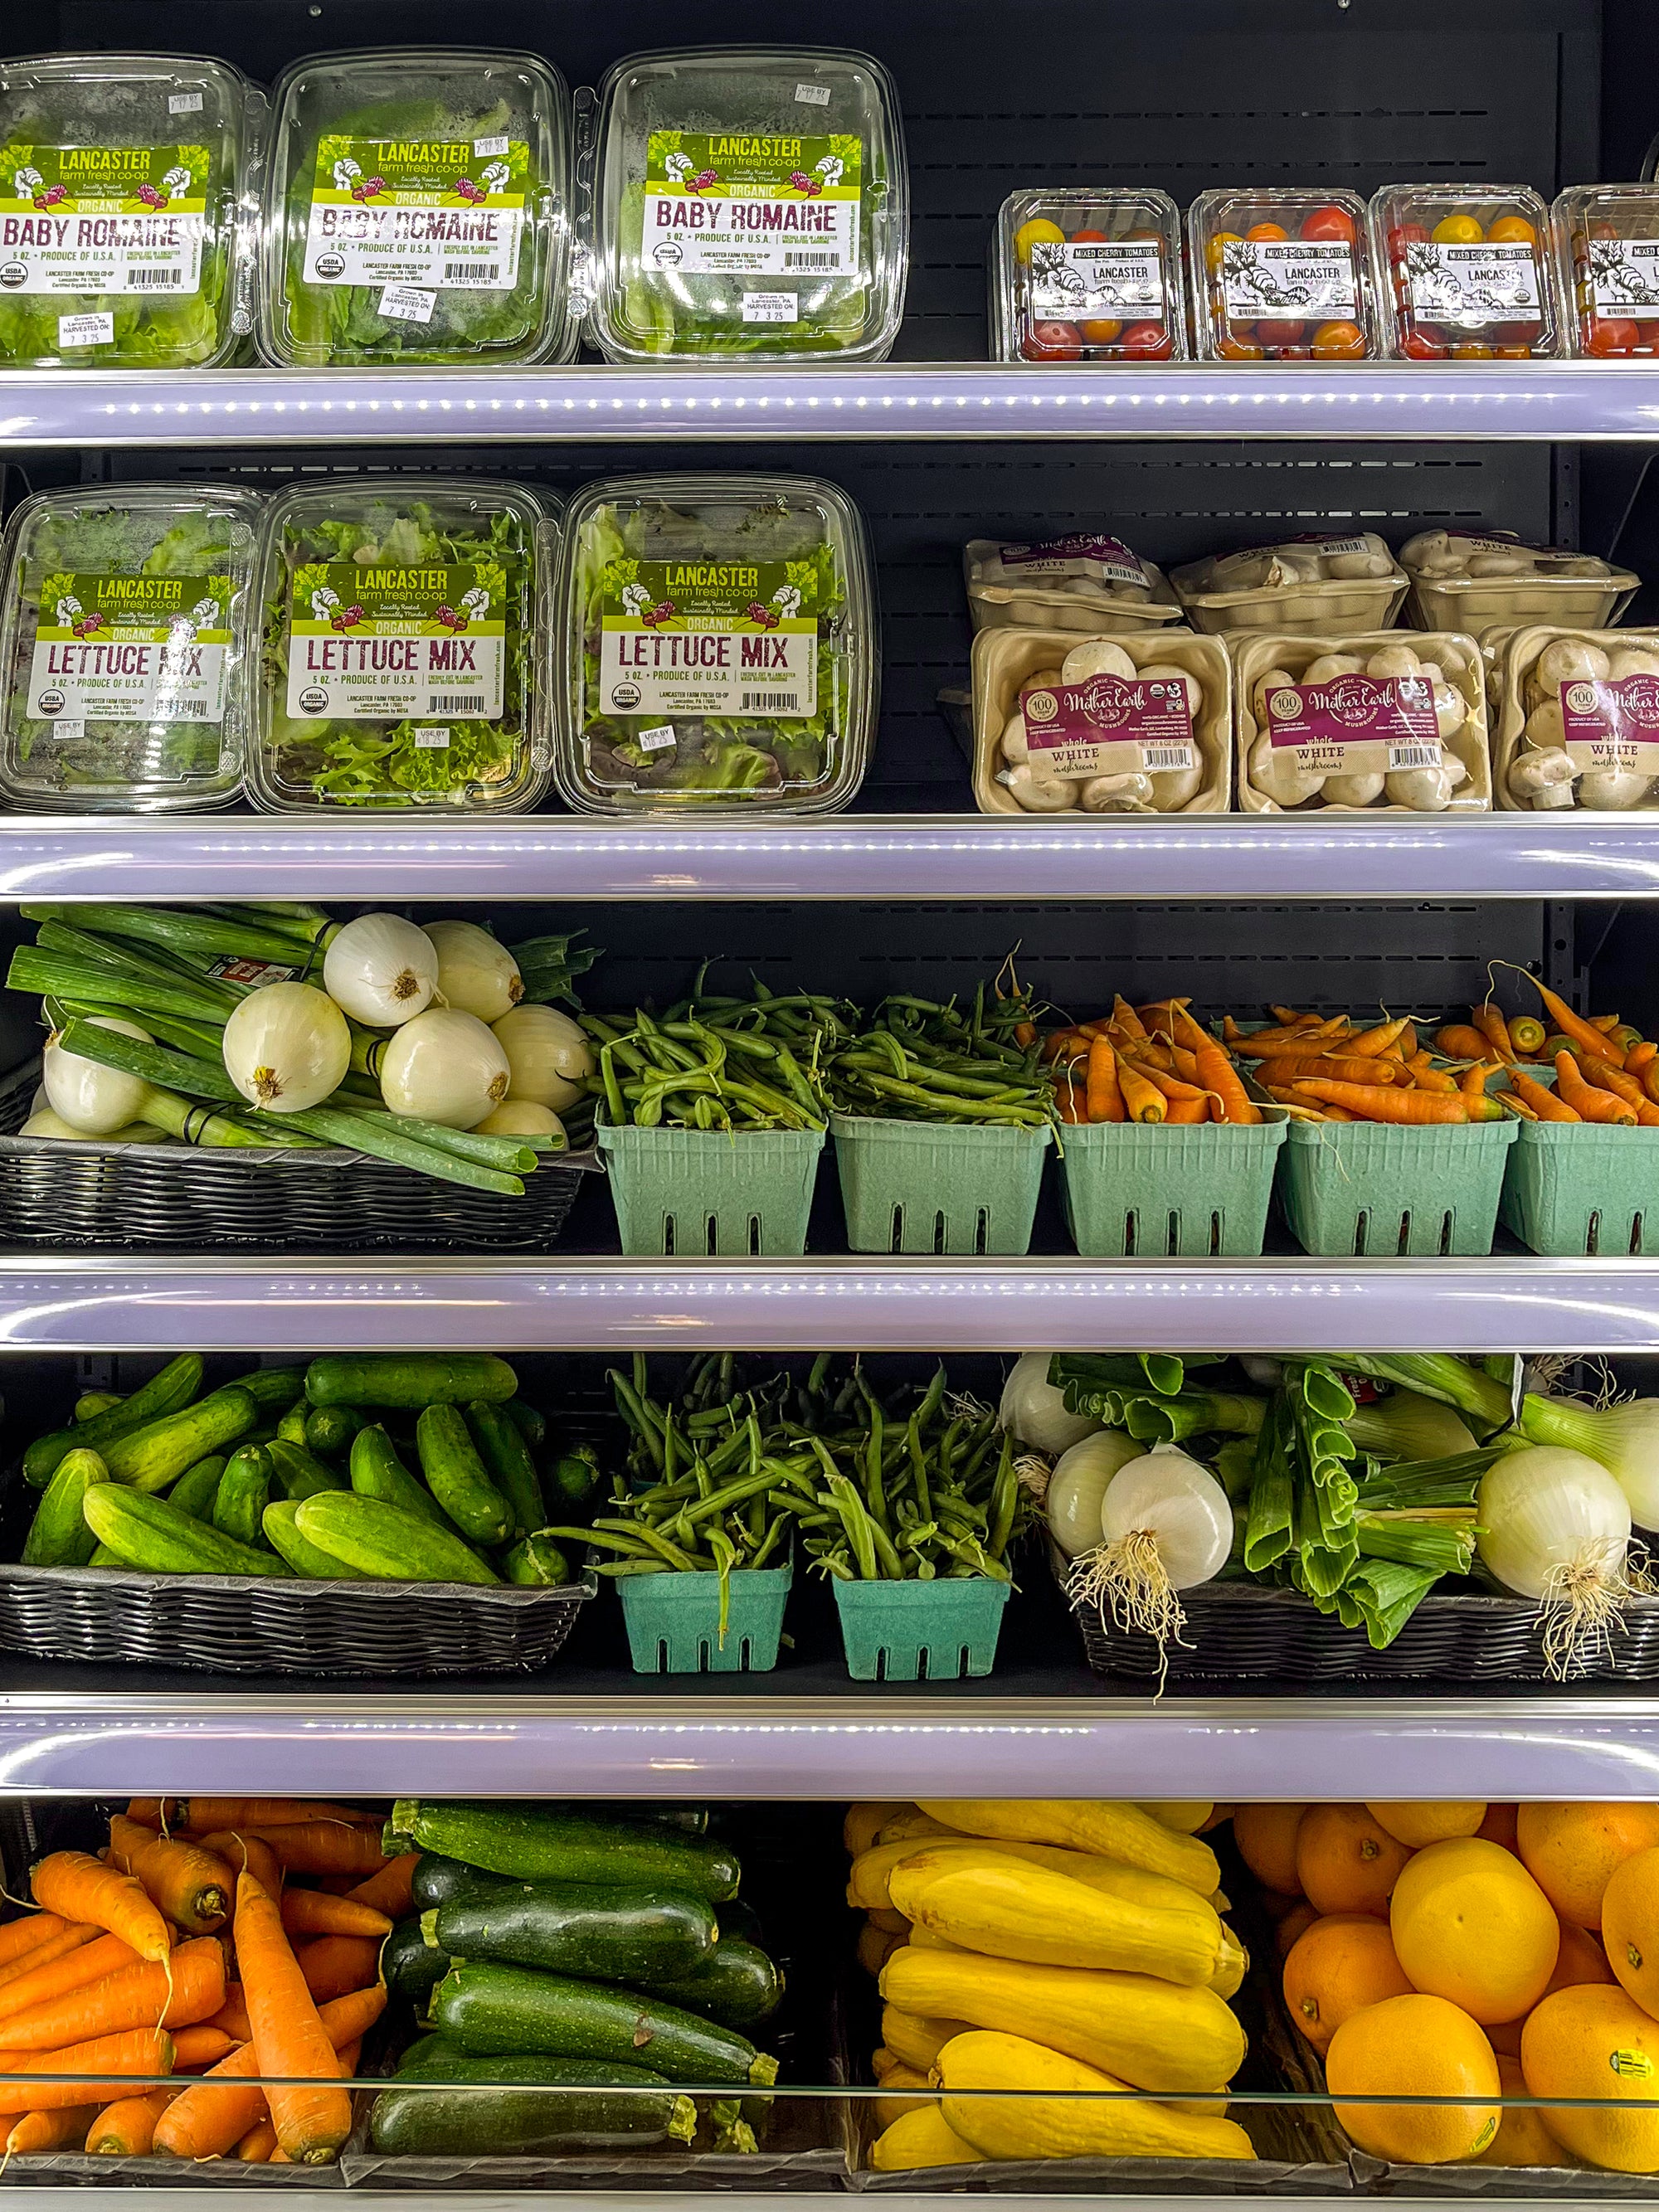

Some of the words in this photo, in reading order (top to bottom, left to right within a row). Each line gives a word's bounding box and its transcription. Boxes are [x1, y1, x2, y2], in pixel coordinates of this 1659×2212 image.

[377, 143, 469, 164] LANCASTER
[708, 137, 801, 157] LANCASTER
[59, 151, 150, 170] LANCASTER
[709, 155, 735, 166] farm
[738, 155, 766, 168] fresh
[378, 163, 403, 172] farm
[406, 163, 434, 174] fresh
[60, 170, 85, 180] farm
[88, 170, 116, 181] fresh
[730, 184, 776, 198] ORGANIC
[396, 192, 440, 206] ORGANIC
[77, 199, 123, 213] ORGANIC
[656, 200, 722, 229] BABY
[731, 203, 837, 231] ROMAINE
[3, 218, 70, 247] BABY
[695, 233, 732, 242] PRODUCE
[735, 234, 745, 243] OF
[331, 243, 335, 251] 5
[358, 243, 395, 253] PRODUCE
[397, 245, 407, 253] OF
[1075, 249, 1096, 258] MIXED
[1097, 249, 1122, 257] CHERRY
[1125, 248, 1158, 257] TOMATOES
[1634, 246, 1654, 255] MIXED
[41, 251, 76, 260] PRODUCE
[80, 251, 90, 260] OF
[1449, 250, 1469, 260] MIXED
[1498, 250, 1532, 259] TOMATOES
[1093, 267, 1148, 279] LANCASTER
[1286, 268, 1340, 279] LANCASTER
[1467, 270, 1524, 281] LANCAS
[754, 312, 758, 320] 7
[766, 312, 771, 320] 3
[774, 312, 783, 320] 25
[355, 570, 448, 590] LANCASTER
[665, 566, 758, 587] LANCASTER
[97, 580, 182, 600] LANCASTER
[356, 590, 382, 600] farm
[385, 590, 413, 601] fresh
[666, 586, 693, 596] farm
[695, 586, 723, 597] fresh
[97, 599, 120, 608] farm
[123, 599, 148, 610] fresh
[376, 620, 422, 634] ORGANIC
[688, 617, 733, 631] ORGANIC
[113, 628, 154, 641] ORGANIC
[307, 639, 419, 670] LETTUCE
[429, 639, 476, 671] MIX
[619, 635, 731, 667] LETTUCE
[742, 637, 788, 668] MIX
[47, 645, 151, 675] LETTUCE
[341, 675, 377, 684] PRODUCE
[381, 675, 391, 684] OF
[625, 671, 630, 679] 5
[653, 671, 690, 680] PRODUCE
[693, 672, 703, 680] OF
[51, 678, 56, 687] 5
[77, 678, 110, 688] PRODUCE
[114, 678, 123, 688] OF
[1083, 678, 1108, 694] ORGANIC
[1329, 678, 1355, 693] ORGANIC
[1063, 687, 1113, 712] Mother
[1114, 685, 1147, 710] Earth
[1277, 697, 1297, 708] 100
[1308, 687, 1360, 711] Mother
[1361, 683, 1395, 708] Earth
[1573, 695, 1593, 703] 100
[1033, 698, 1052, 711] 100
[1099, 708, 1131, 729] MUSHROOMS
[1345, 707, 1379, 727] MUSHROOMS
[1061, 737, 1087, 746] whole
[1306, 735, 1333, 745] whole
[1052, 748, 1100, 762] WHITE
[1297, 746, 1345, 759] WHITE
[1591, 745, 1638, 756] WHITE
[1347, 1374, 1361, 1398] Fresh
